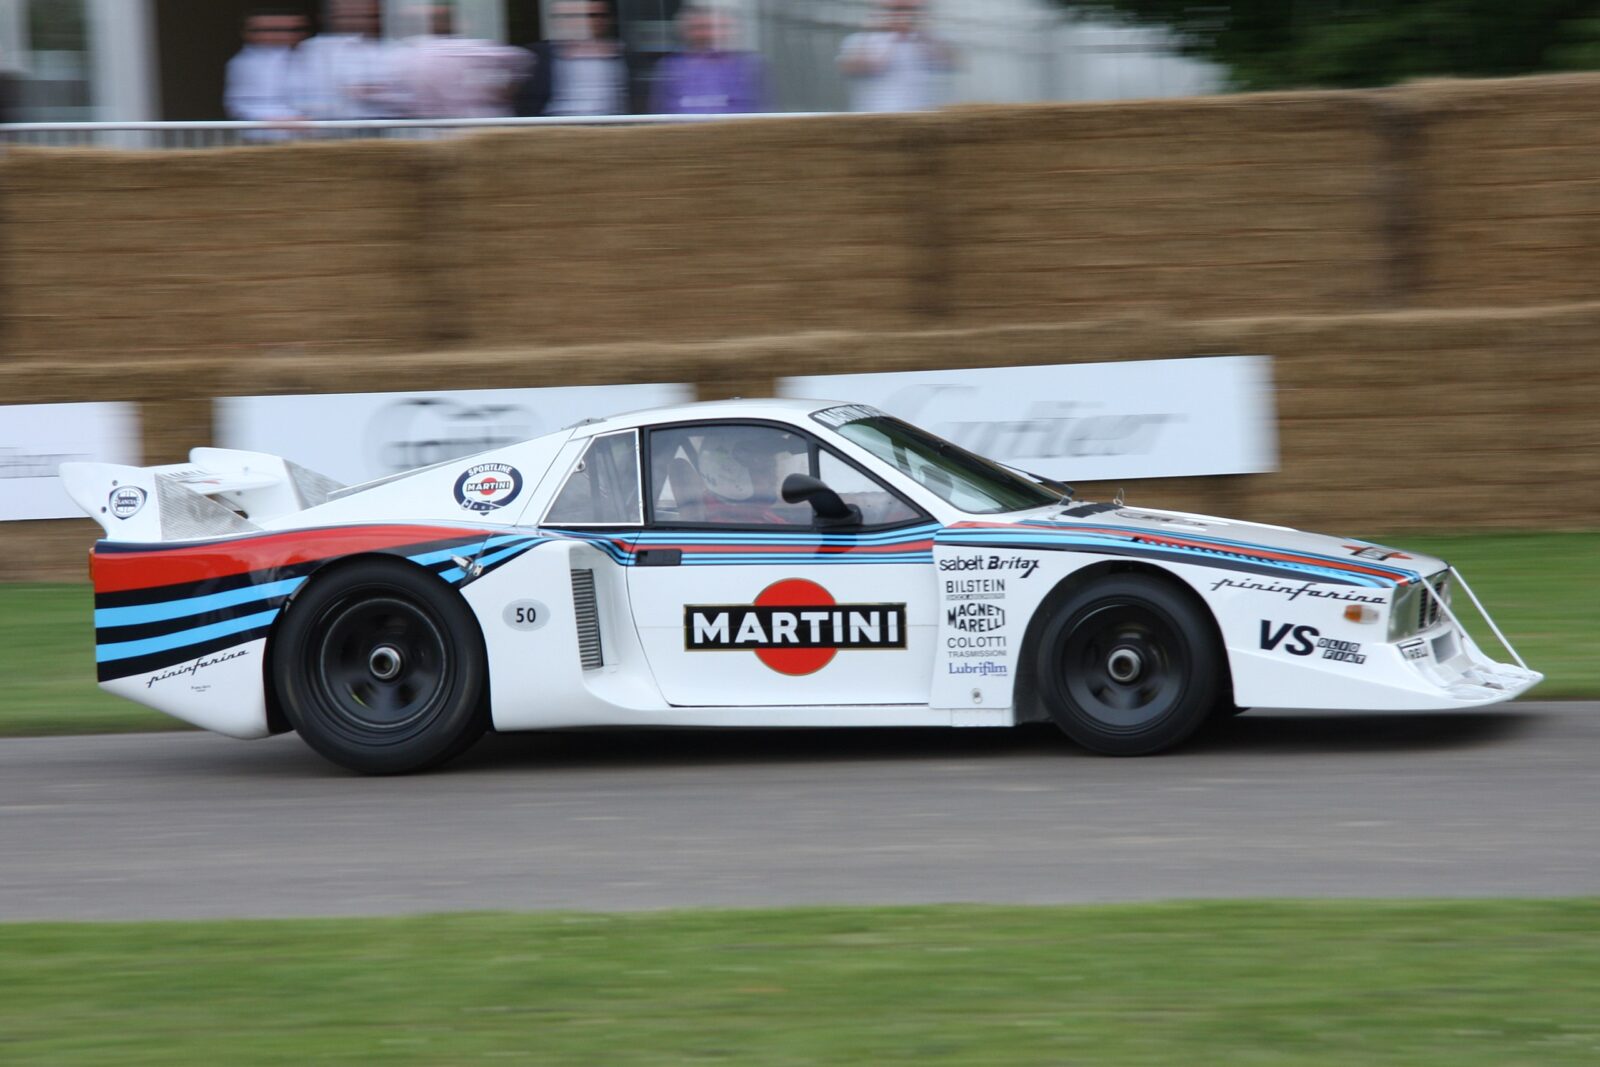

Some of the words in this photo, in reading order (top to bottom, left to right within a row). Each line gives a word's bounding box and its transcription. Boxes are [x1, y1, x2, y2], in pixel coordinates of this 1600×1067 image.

[468, 463, 513, 477] SPORTLINE
[467, 481, 510, 491] MARTINI
[939, 555, 983, 571] sabelt
[987, 555, 1040, 578] Britax
[946, 579, 1006, 593] BILSTEIN
[1210, 577, 1388, 604] pininfarina
[516, 607, 536, 623] 50
[693, 611, 898, 644] MARTINI
[947, 636, 1006, 648] COLOTTI
[1259, 619, 1321, 656] VS
[1323, 650, 1366, 664] FIAT
[146, 650, 249, 688] pininfarina
[949, 661, 1007, 676] Lubrifilm
